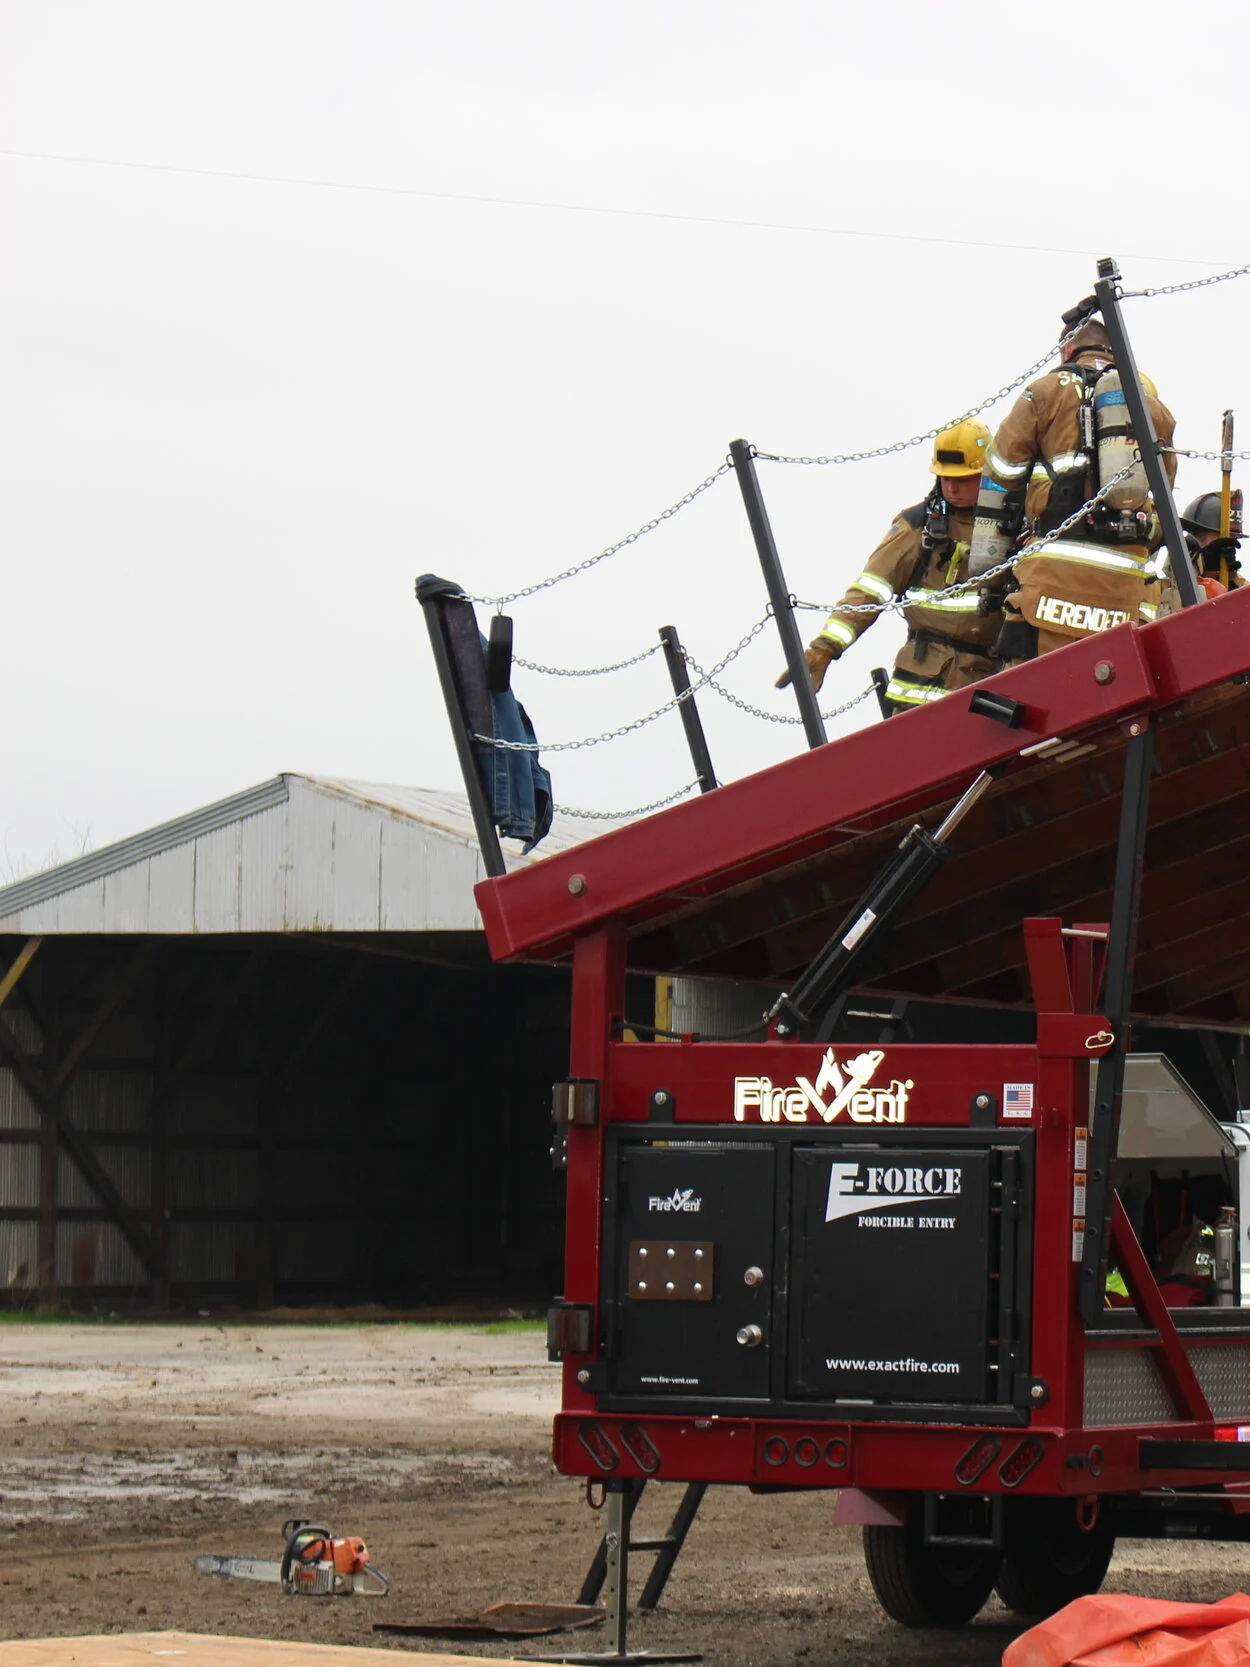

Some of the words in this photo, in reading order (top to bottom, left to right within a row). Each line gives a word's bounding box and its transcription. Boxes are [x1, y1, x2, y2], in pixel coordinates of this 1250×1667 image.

[734, 1066, 909, 1123] FireVent
[825, 1162, 962, 1212] E-FORCE
[648, 1192, 702, 1212] FireVent
[858, 1216, 914, 1228] FORCIBLE
[918, 1217, 956, 1229] ENTRY
[826, 1358, 960, 1374] www.exactfire.com
[640, 1376, 699, 1385] www.fire-vent.com
